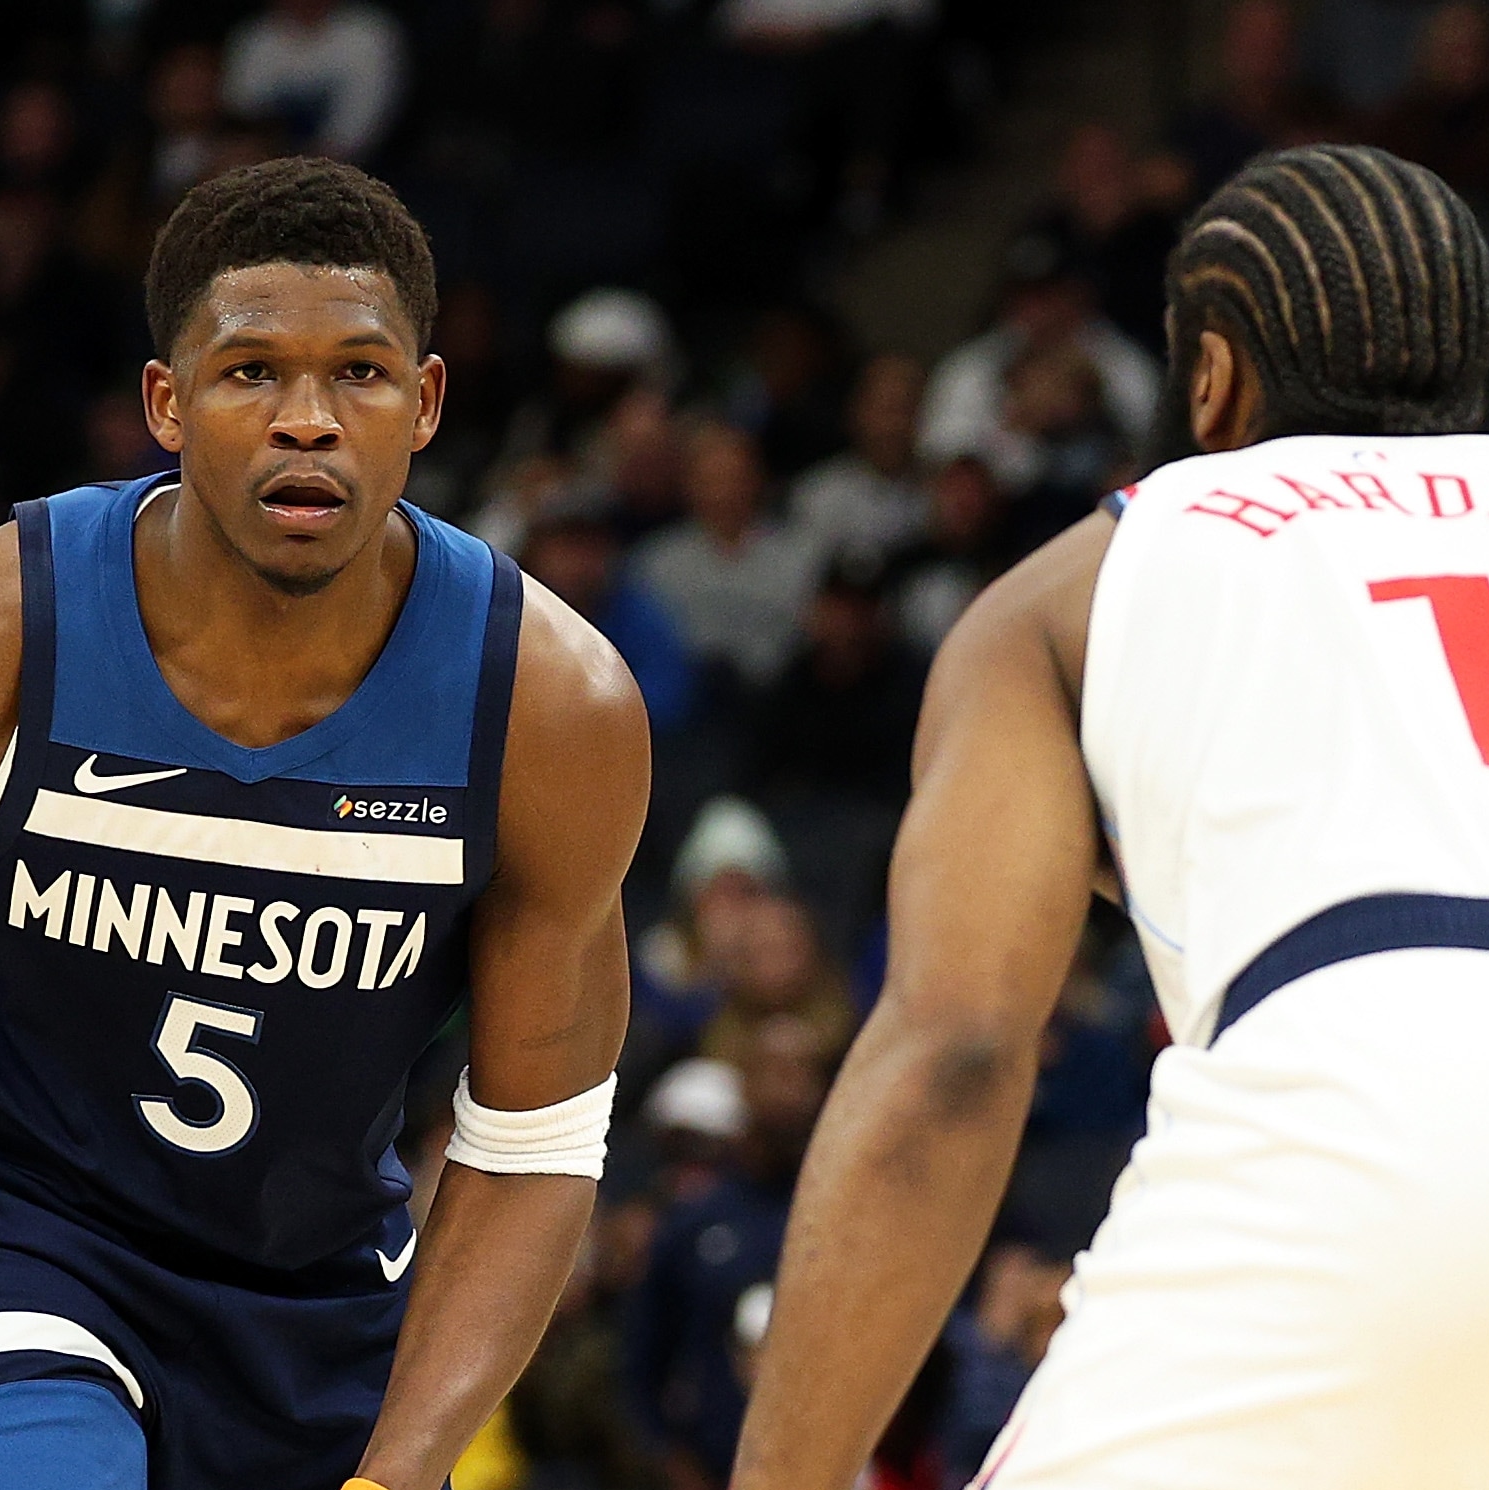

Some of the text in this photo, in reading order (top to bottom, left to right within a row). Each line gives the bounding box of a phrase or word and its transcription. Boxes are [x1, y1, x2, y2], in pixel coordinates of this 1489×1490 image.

[353, 796, 448, 825] sezzle
[7, 858, 427, 991] MINNESOTA
[132, 991, 265, 1158] 5
